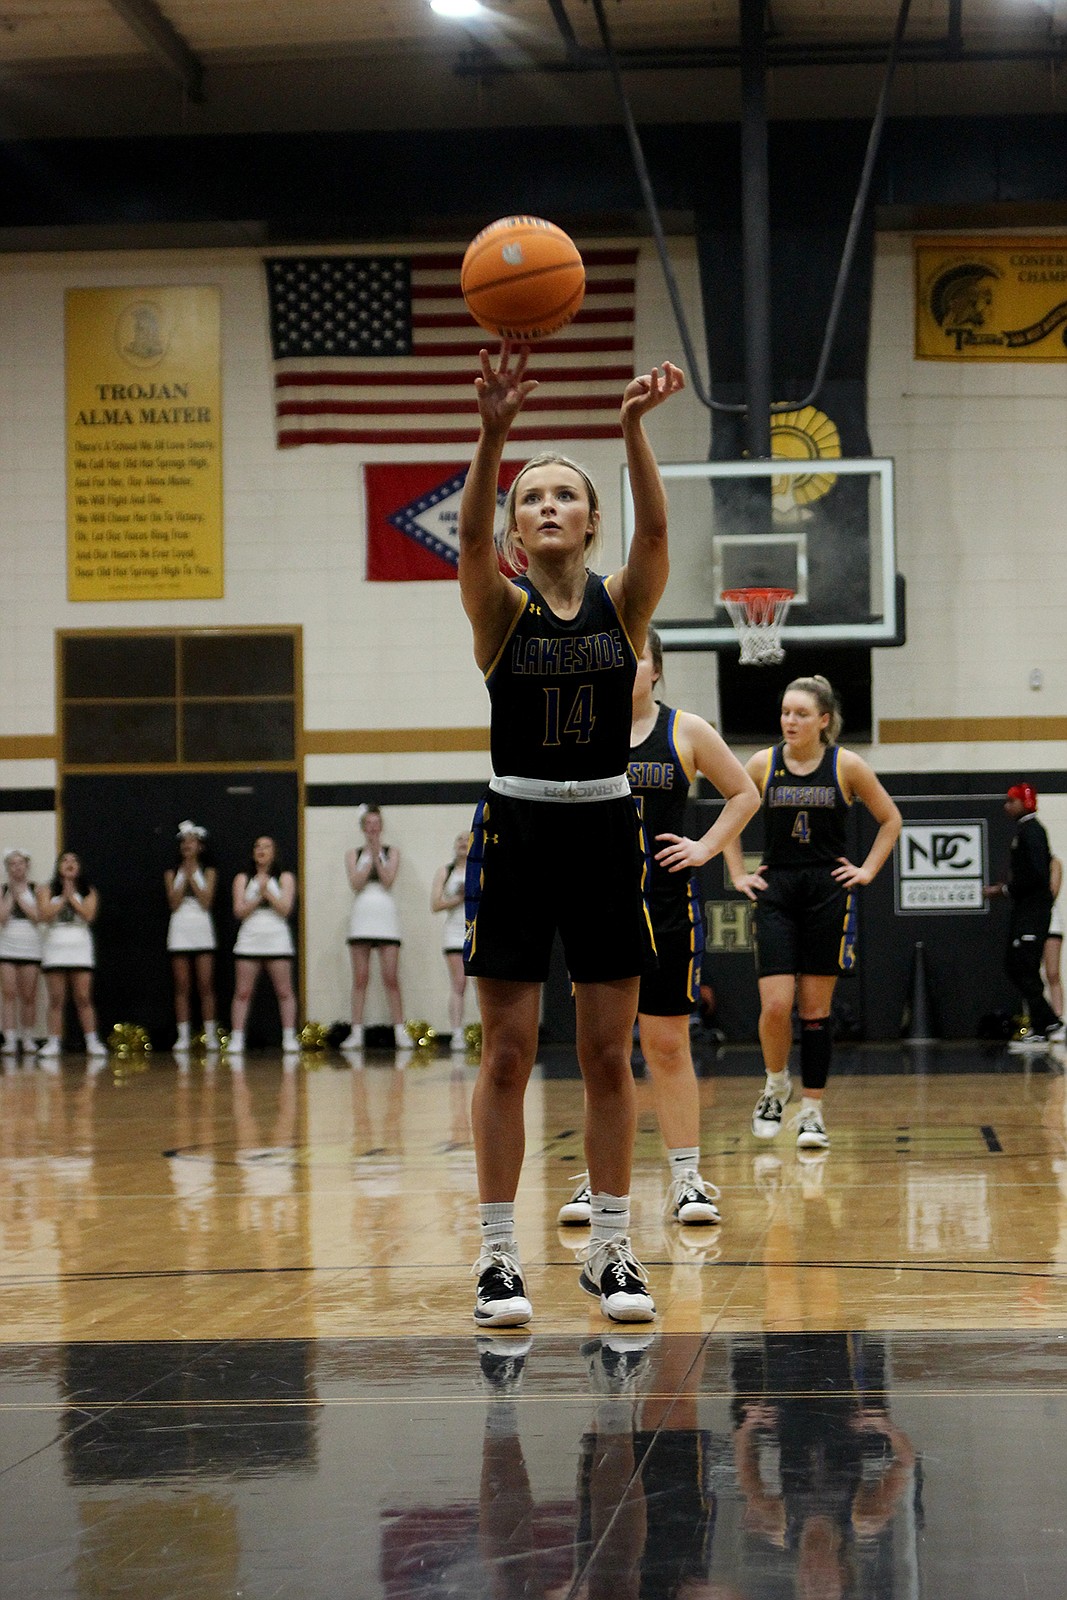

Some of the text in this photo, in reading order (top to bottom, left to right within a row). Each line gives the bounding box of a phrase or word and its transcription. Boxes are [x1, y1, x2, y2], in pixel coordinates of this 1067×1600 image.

[95, 382, 189, 400] TROJAN
[75, 406, 211, 426] ALMA MATER
[511, 629, 624, 675] LAKESIDE
[542, 685, 597, 746] 14
[768, 785, 836, 809] LAKESIDE
[791, 810, 811, 844] 4
[906, 831, 972, 870] NPC
